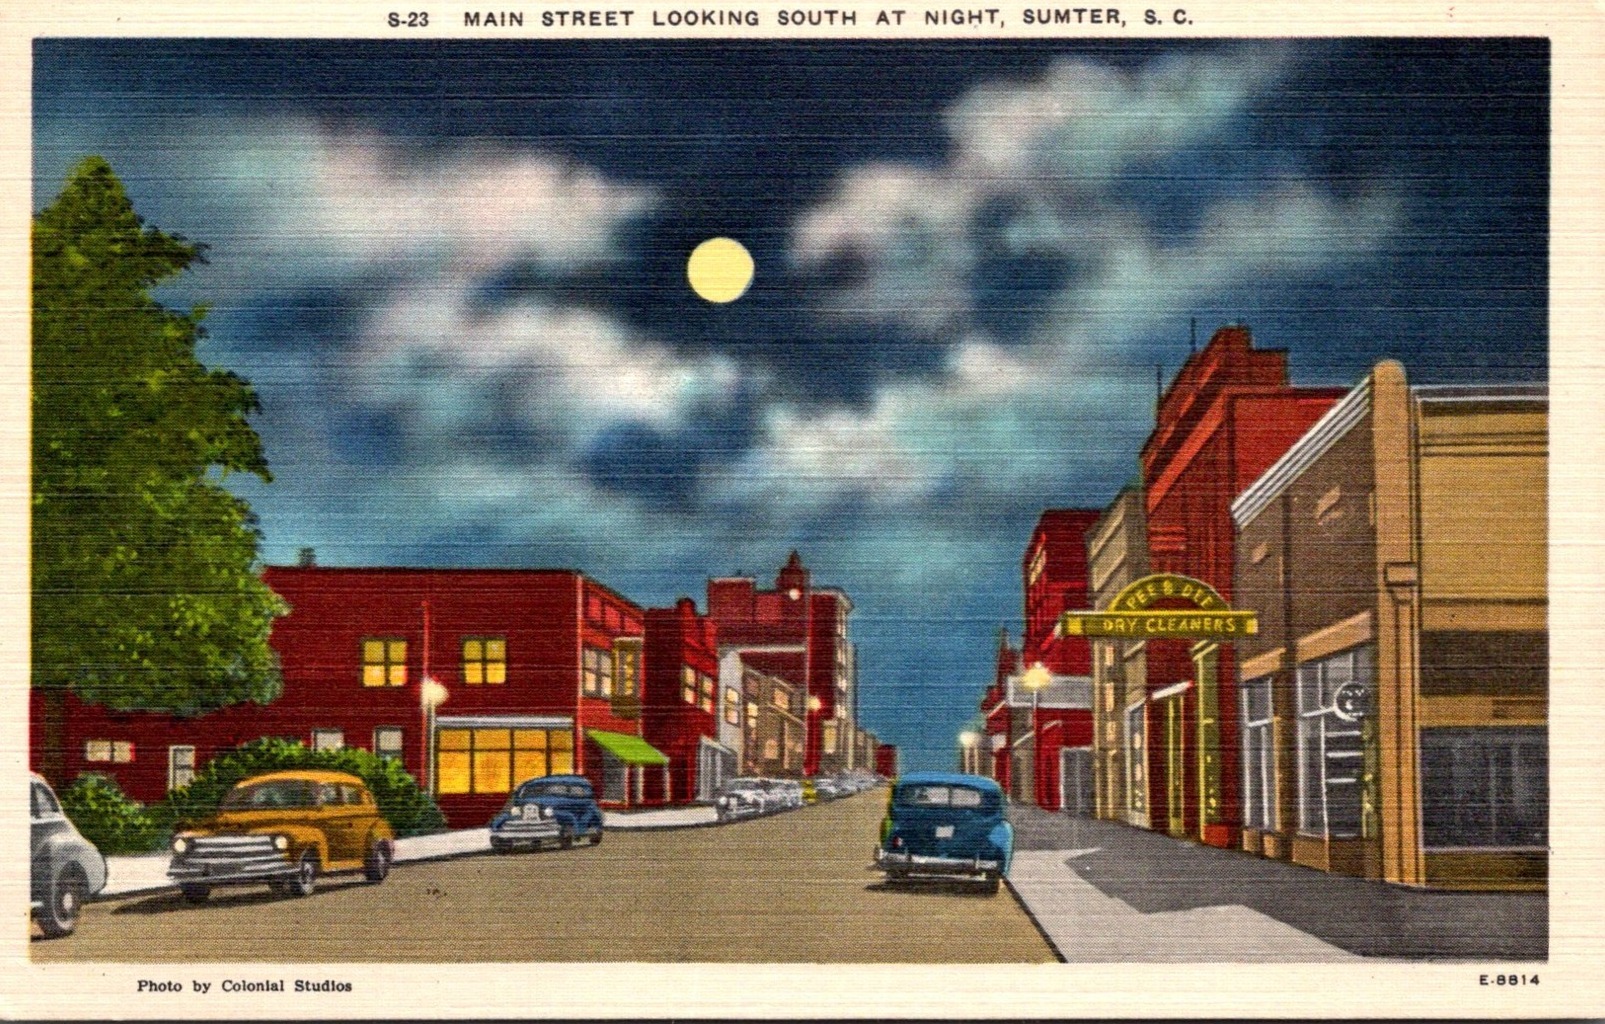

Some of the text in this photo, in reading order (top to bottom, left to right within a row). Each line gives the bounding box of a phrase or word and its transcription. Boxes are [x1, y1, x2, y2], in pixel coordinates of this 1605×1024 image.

[1126, 580, 1214, 609] PEE & DEE
[1103, 617, 1236, 632] DRY CLEANERS
